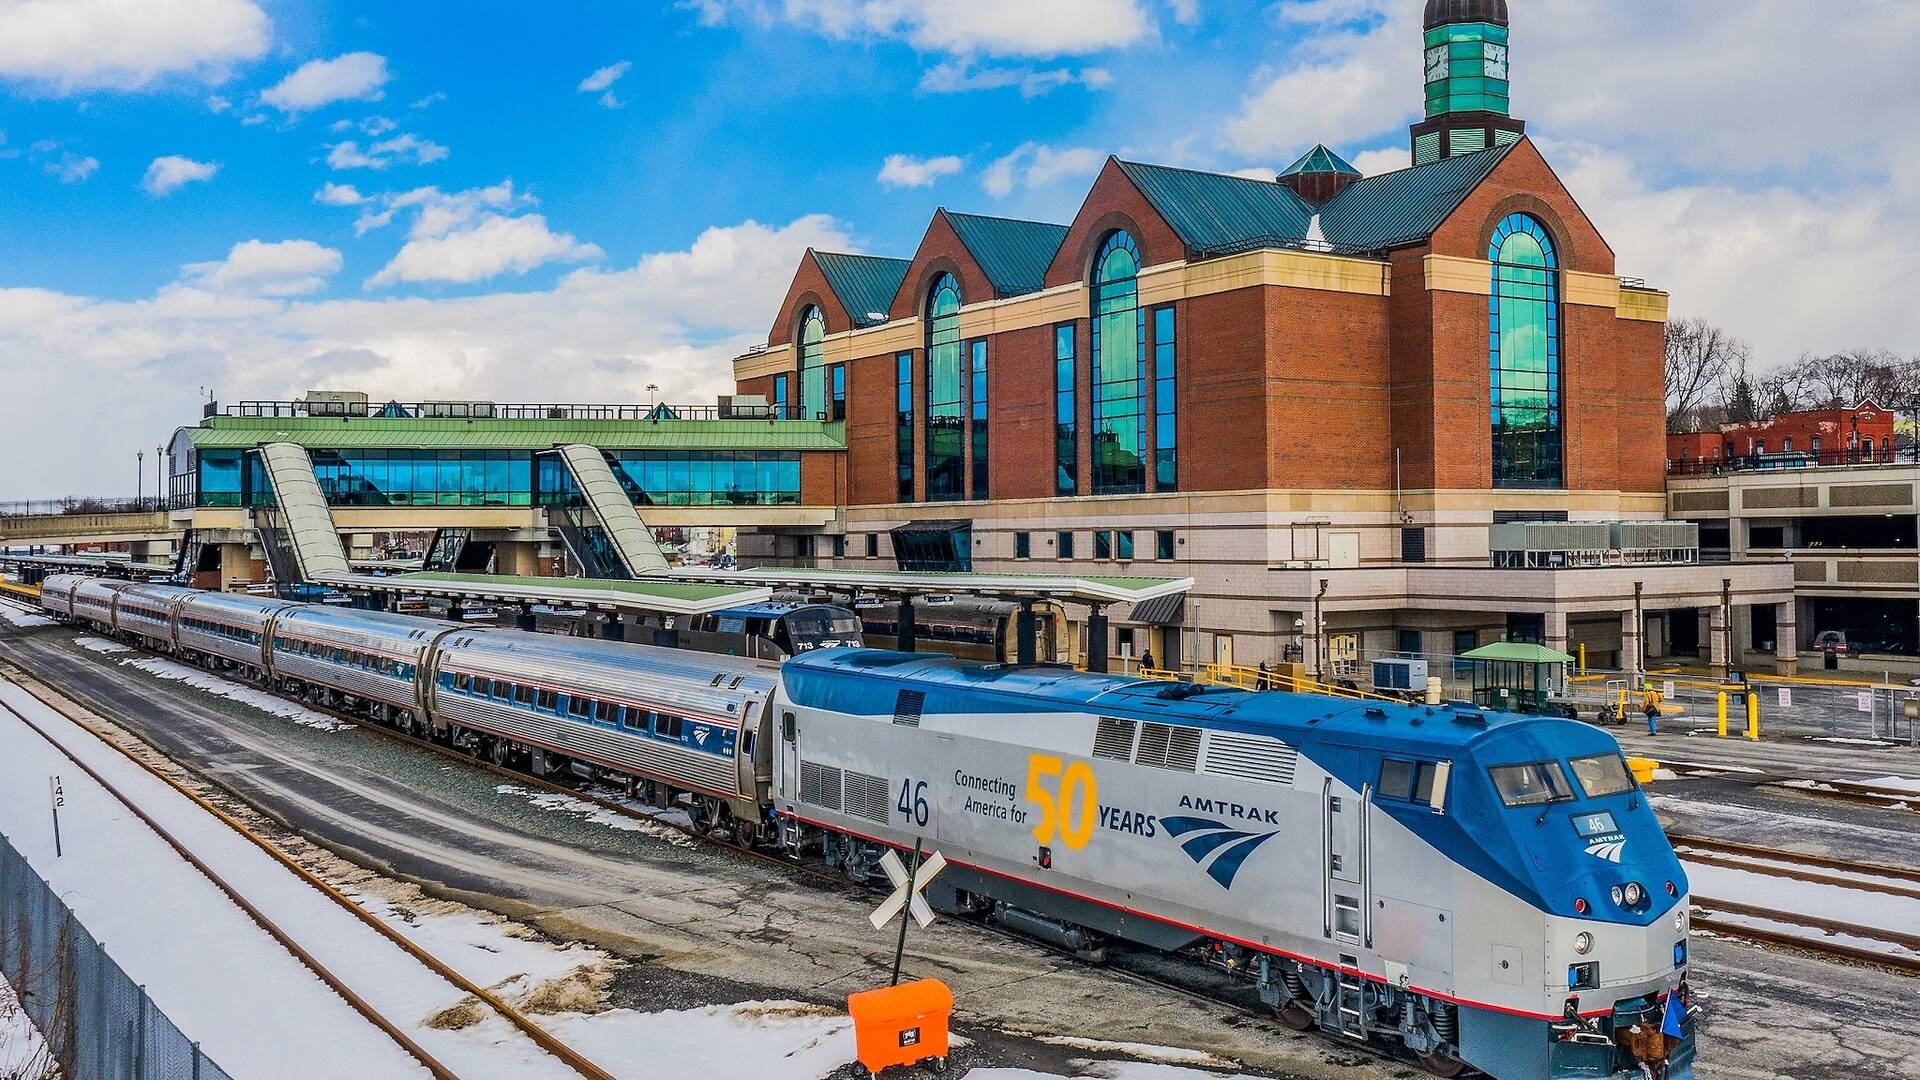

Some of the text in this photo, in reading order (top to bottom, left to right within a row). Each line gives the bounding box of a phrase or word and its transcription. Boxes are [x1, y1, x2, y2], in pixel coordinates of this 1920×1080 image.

[797, 642, 814, 650] 713
[955, 769, 1016, 801] Connecting
[897, 778, 929, 827] 46
[964, 795, 1028, 824] America for
[1025, 752, 1098, 850] 50
[1178, 795, 1280, 825] AMTRAK
[1098, 804, 1157, 838] YEARS
[1589, 817, 1605, 832] 46
[1589, 833, 1626, 845] AMTRAK
